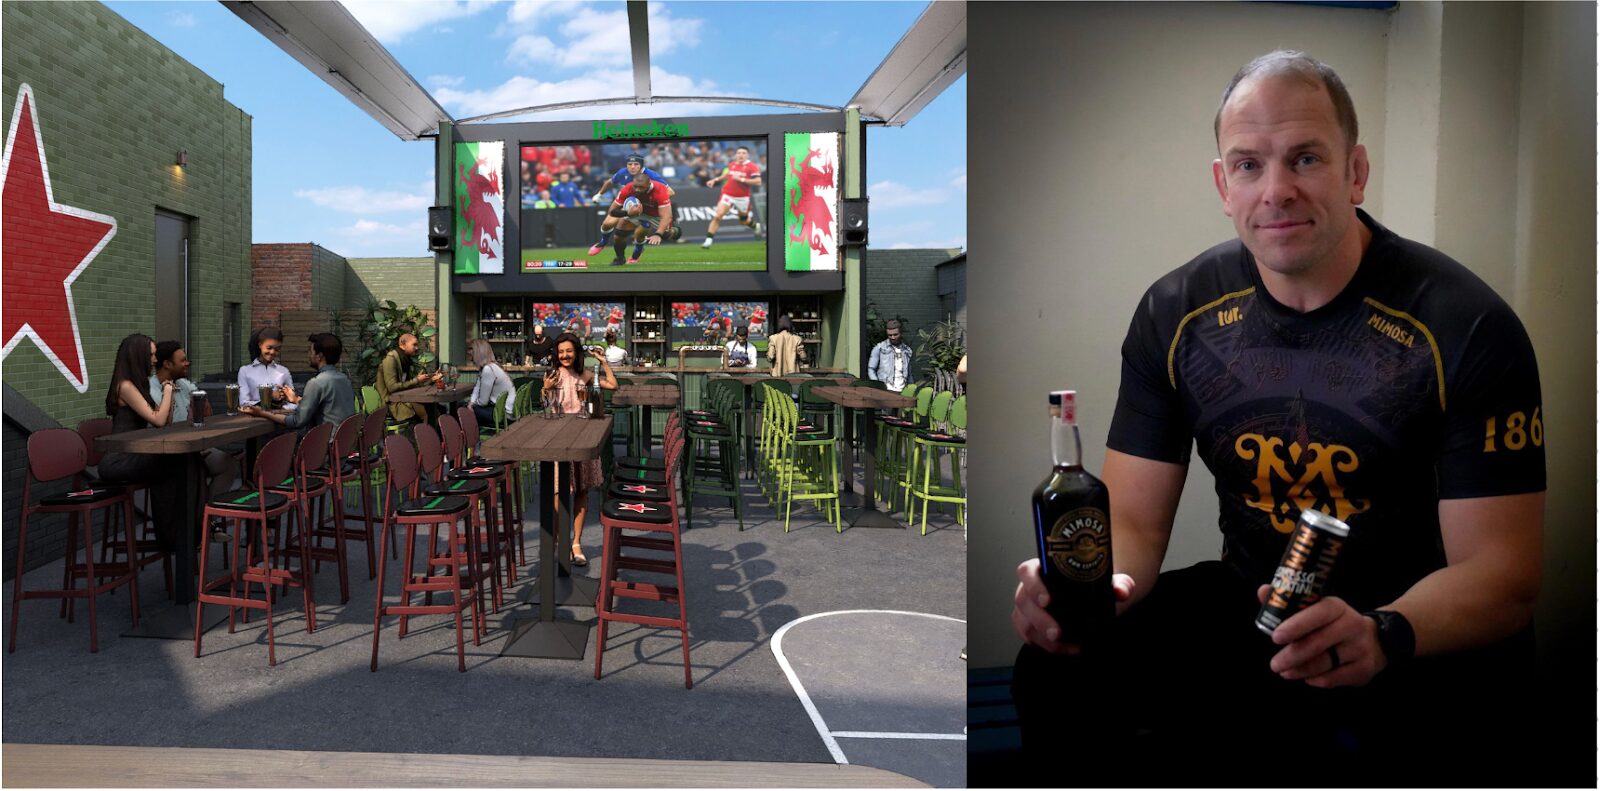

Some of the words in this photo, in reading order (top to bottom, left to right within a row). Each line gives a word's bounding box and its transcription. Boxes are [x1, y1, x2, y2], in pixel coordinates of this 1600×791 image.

[592, 119, 689, 139] Heineken
[1367, 313, 1415, 348] MIMOSA
[1062, 517, 1104, 539] MIMOSA
